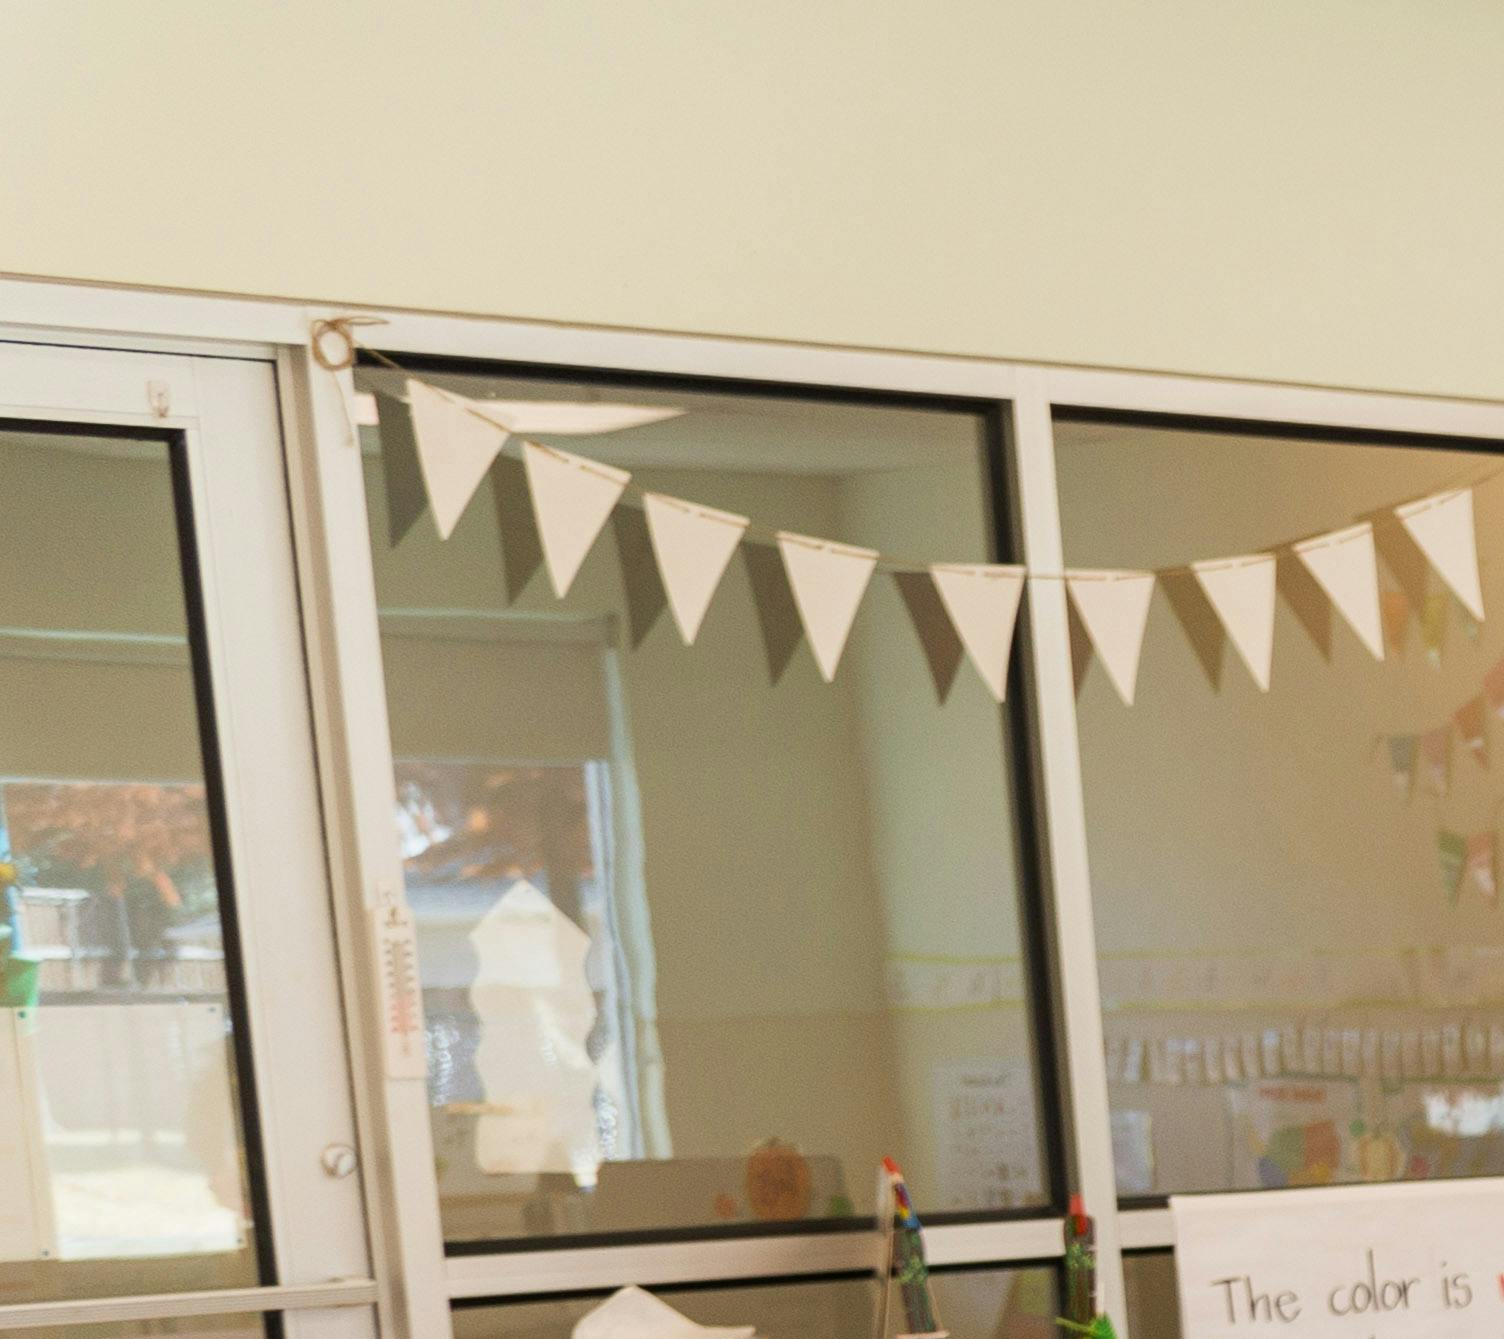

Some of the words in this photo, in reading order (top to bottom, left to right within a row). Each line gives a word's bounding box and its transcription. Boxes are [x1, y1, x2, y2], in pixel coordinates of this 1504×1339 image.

[1211, 1275, 1302, 1325] The
[1328, 1248, 1421, 1317] color
[1441, 1261, 1474, 1309] is
